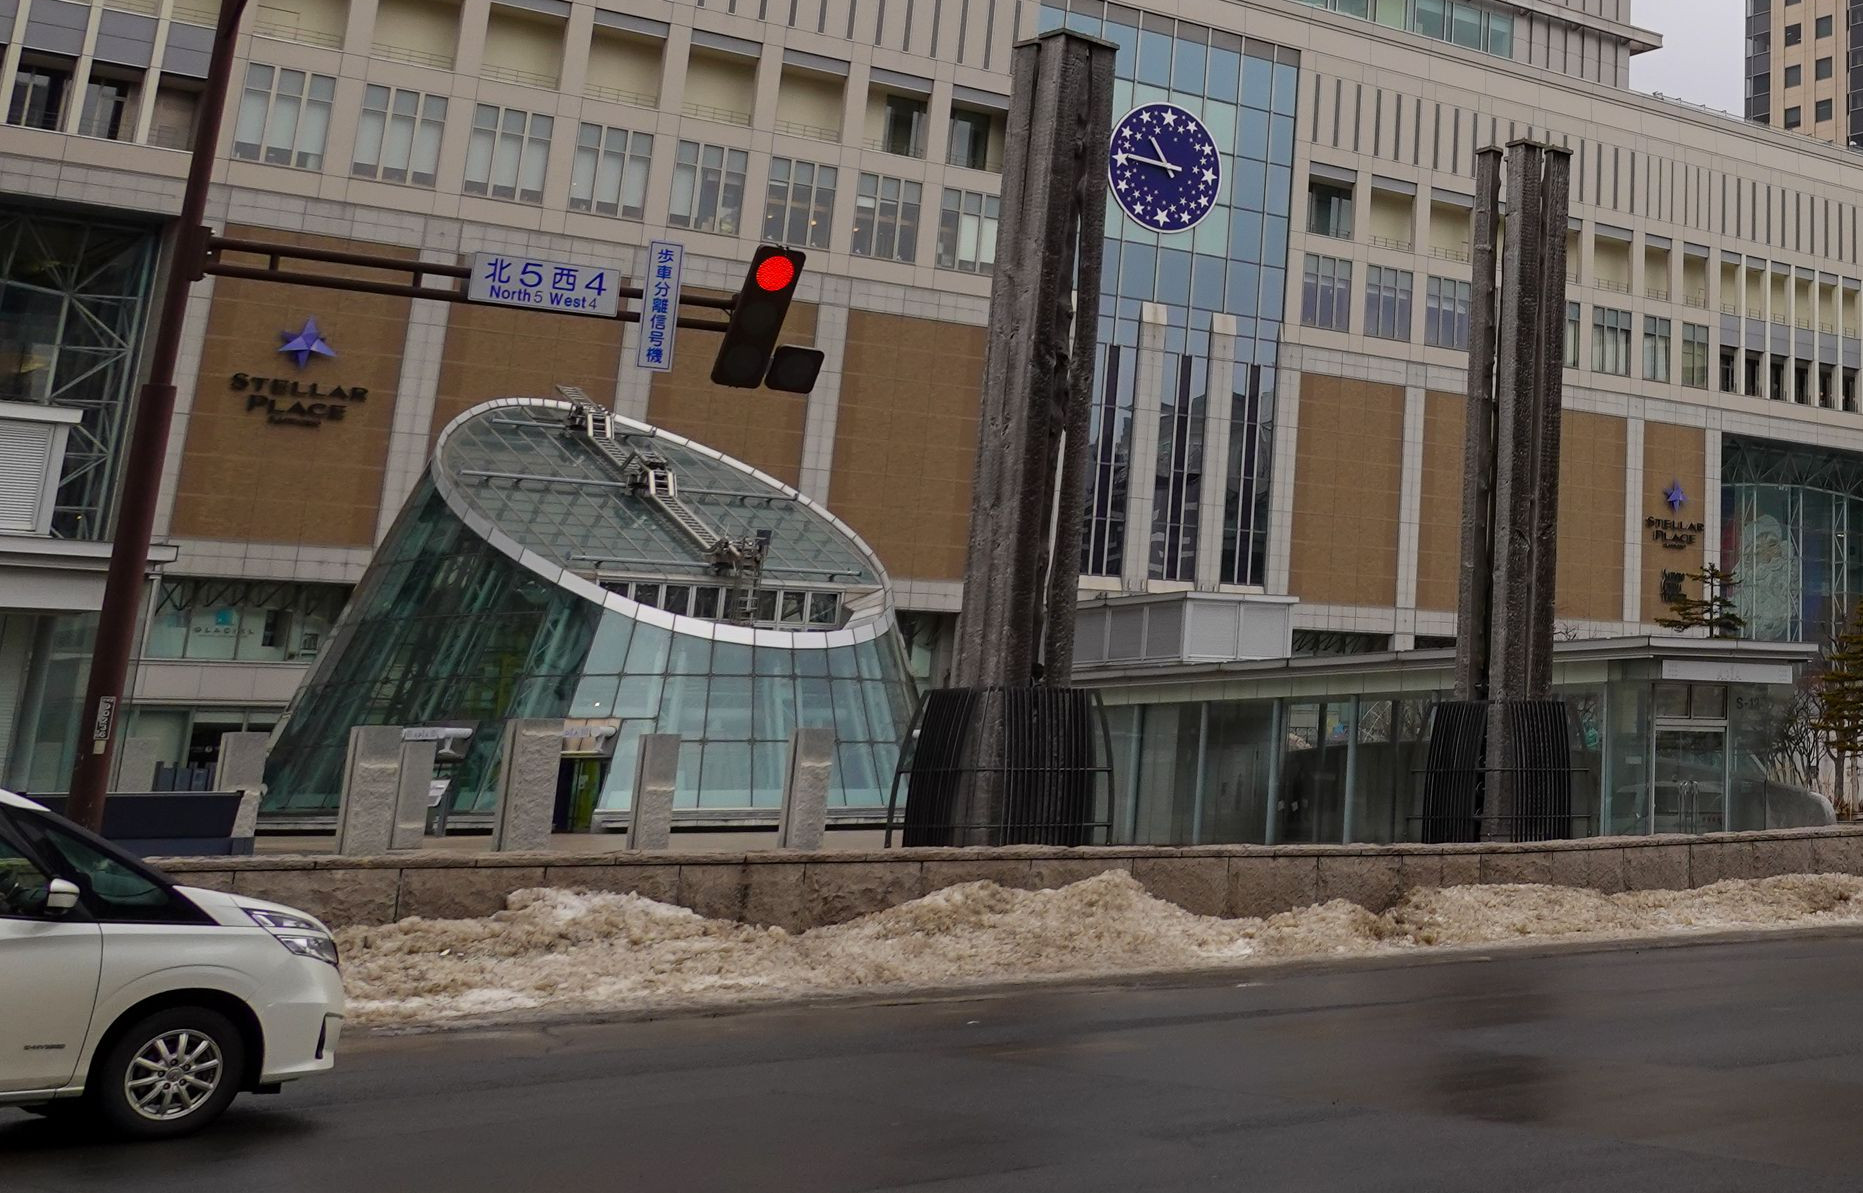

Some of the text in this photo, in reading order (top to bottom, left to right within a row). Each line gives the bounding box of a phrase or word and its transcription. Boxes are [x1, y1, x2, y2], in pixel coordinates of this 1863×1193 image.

[484, 258, 607, 297] 北5西4
[489, 285, 598, 310] North 5 West 4
[646, 248, 675, 364] 歩車分離信号機
[230, 372, 369, 403] STELLAR
[246, 394, 348, 421] PLACE
[1645, 515, 1705, 533] STELLAR
